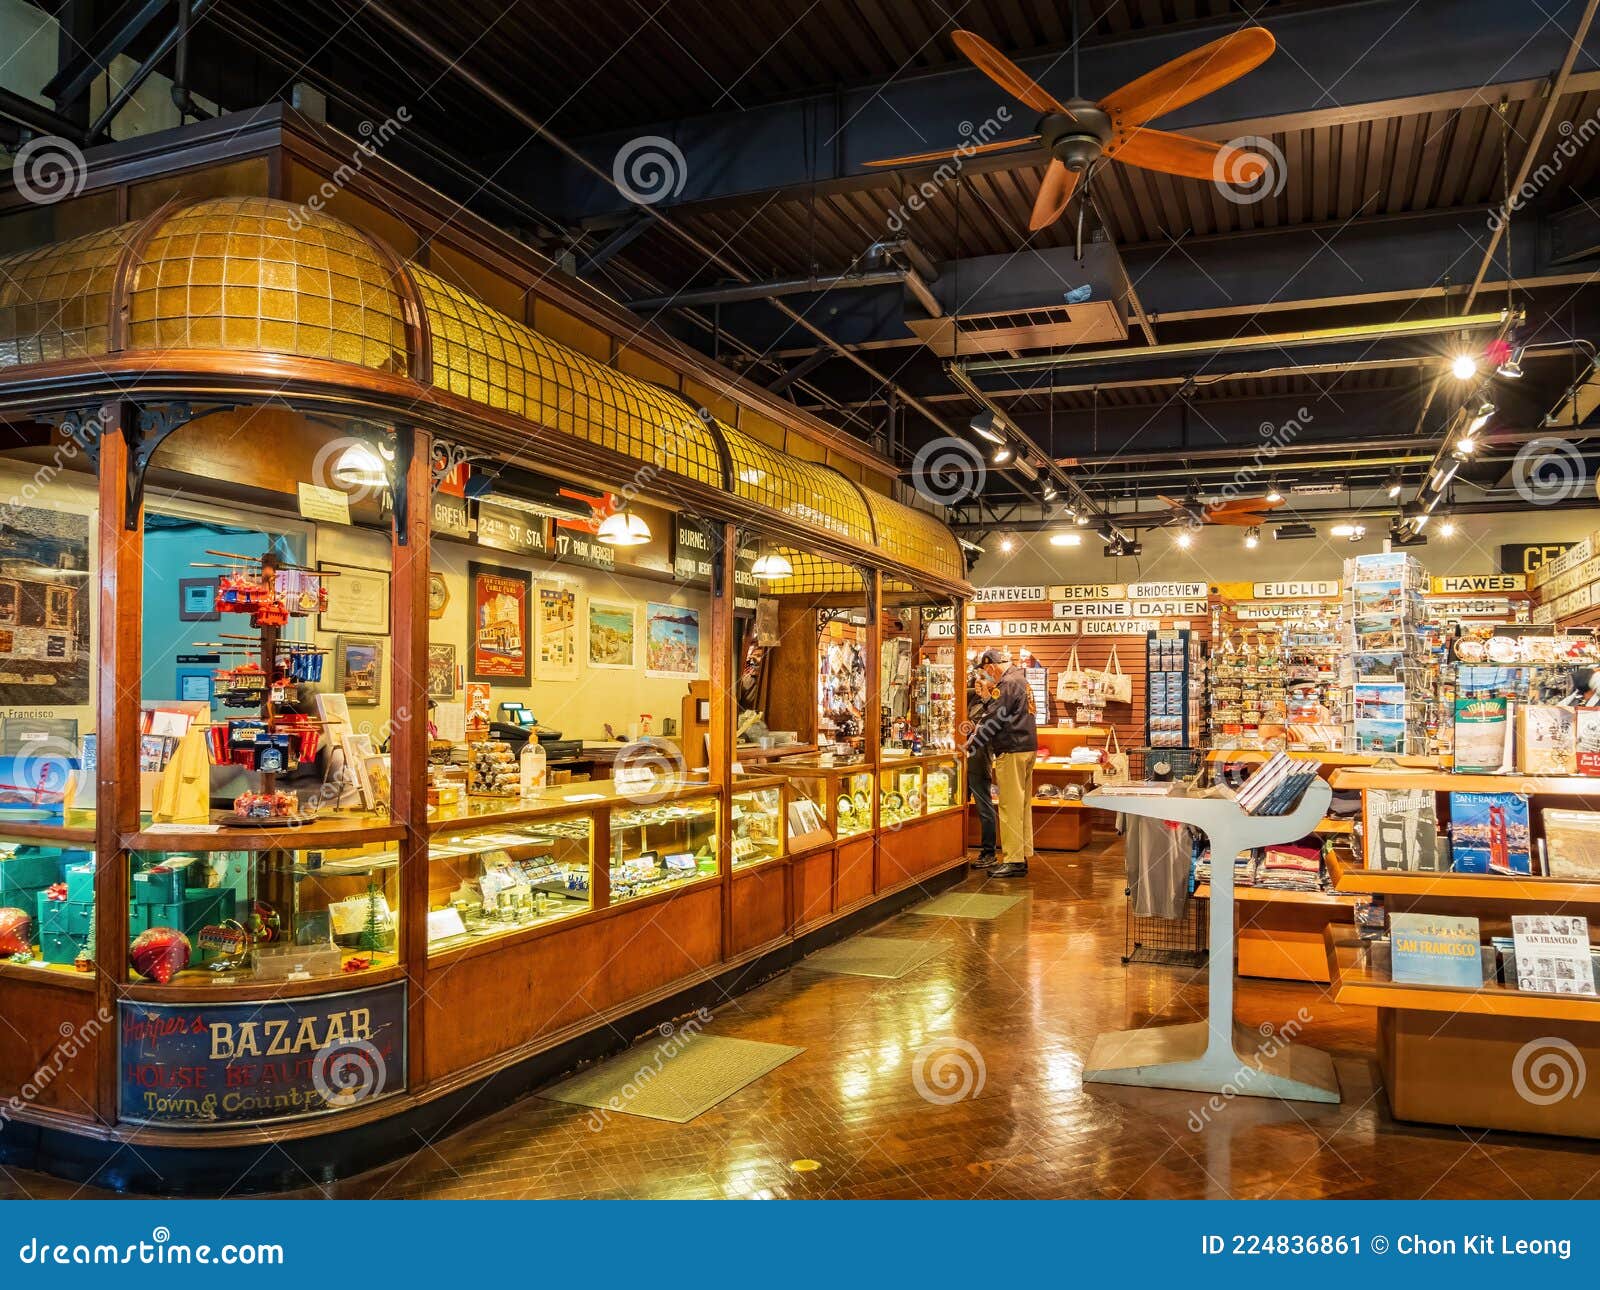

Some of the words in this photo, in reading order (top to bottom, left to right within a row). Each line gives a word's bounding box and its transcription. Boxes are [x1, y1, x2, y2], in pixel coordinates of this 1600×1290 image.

[434, 503, 466, 530] GREEN
[1136, 584, 1200, 597] BRIDGEVIEW
[1264, 583, 1328, 596] EUCLID
[1445, 577, 1516, 591] HAWES
[976, 588, 1042, 601] BARNEVELD
[1064, 586, 1110, 598] BEMIS
[1062, 603, 1125, 616] PERINE
[1139, 602, 1208, 615] DARIEN
[1008, 622, 1072, 634] DORMAN
[9, 708, 54, 719] Francisco
[1525, 935, 1539, 944] SAN
[1541, 936, 1578, 945] FRANCISCO
[1396, 938, 1417, 953] SAN
[1420, 941, 1476, 957] FRANCISCO
[209, 1007, 374, 1060] BAZAAR
[128, 1064, 208, 1090] HOUSE
